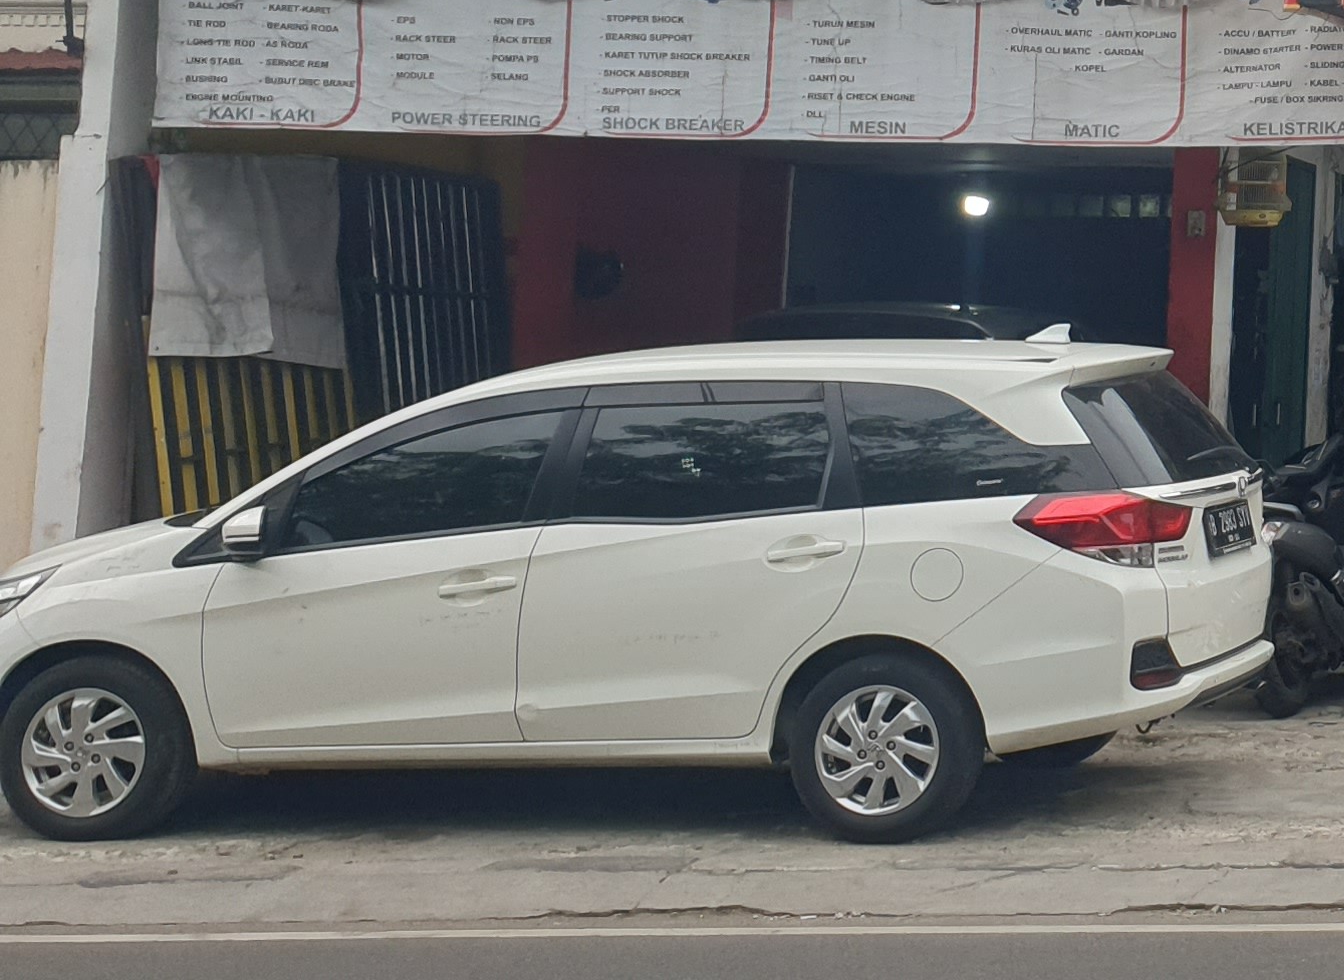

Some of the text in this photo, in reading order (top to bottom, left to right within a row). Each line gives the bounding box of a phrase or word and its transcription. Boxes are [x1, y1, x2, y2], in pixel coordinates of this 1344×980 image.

[1065, 29, 1092, 37] MATIC
[1063, 47, 1091, 55] MATIC
[1310, 61, 1344, 69] SLIDING
[1310, 79, 1338, 87] KABEL
[1308, 95, 1343, 103] SIKRING
[209, 107, 314, 122] KAKI KAKI
[392, 112, 541, 127] POWER STEERING
[602, 117, 744, 131] SHOCK BREAKER
[850, 121, 906, 134] MESIN
[1065, 124, 1119, 138] MATIC
